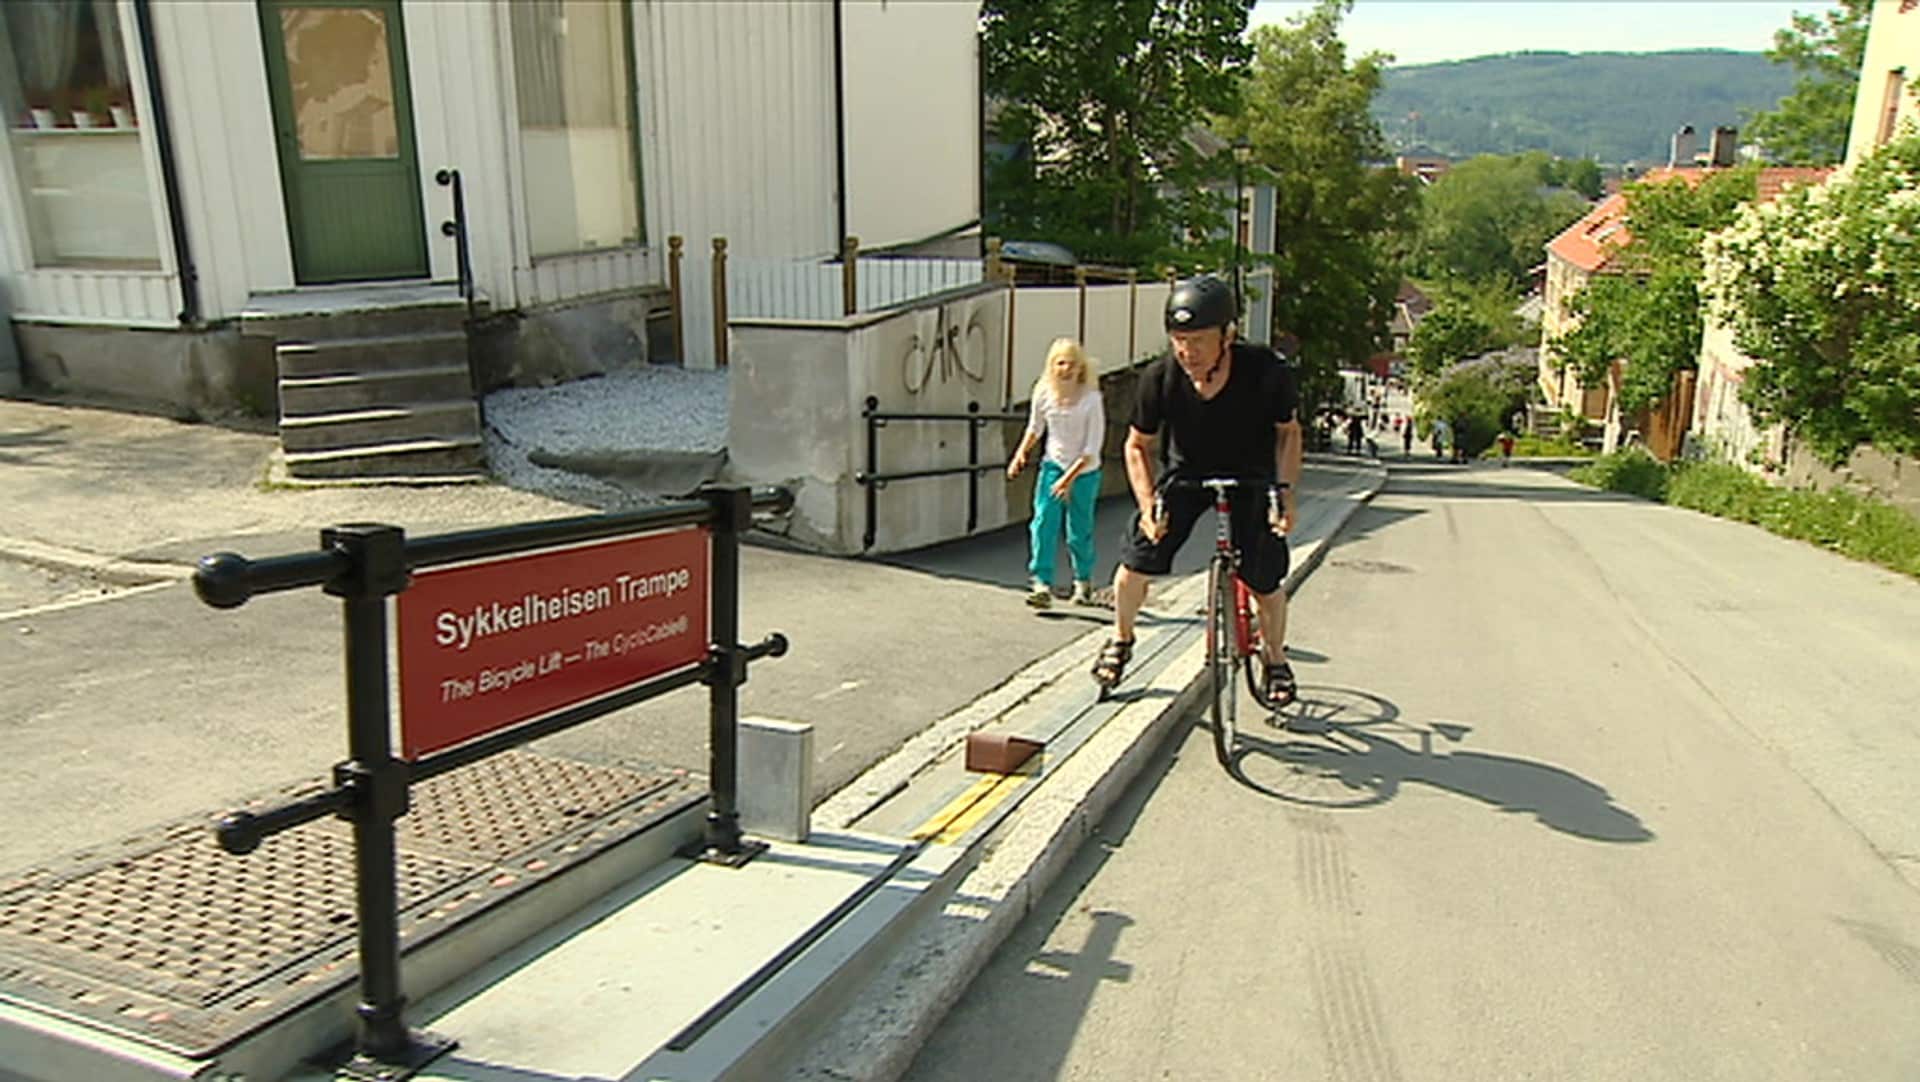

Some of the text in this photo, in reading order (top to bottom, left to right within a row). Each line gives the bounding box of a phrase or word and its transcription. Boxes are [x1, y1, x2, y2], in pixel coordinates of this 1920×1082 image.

[436, 569, 691, 649] Sykkelheisen Trampe
[441, 679, 474, 702] The
[477, 661, 536, 693] Bicycle
[538, 651, 564, 676] Lift
[585, 640, 610, 661] The
